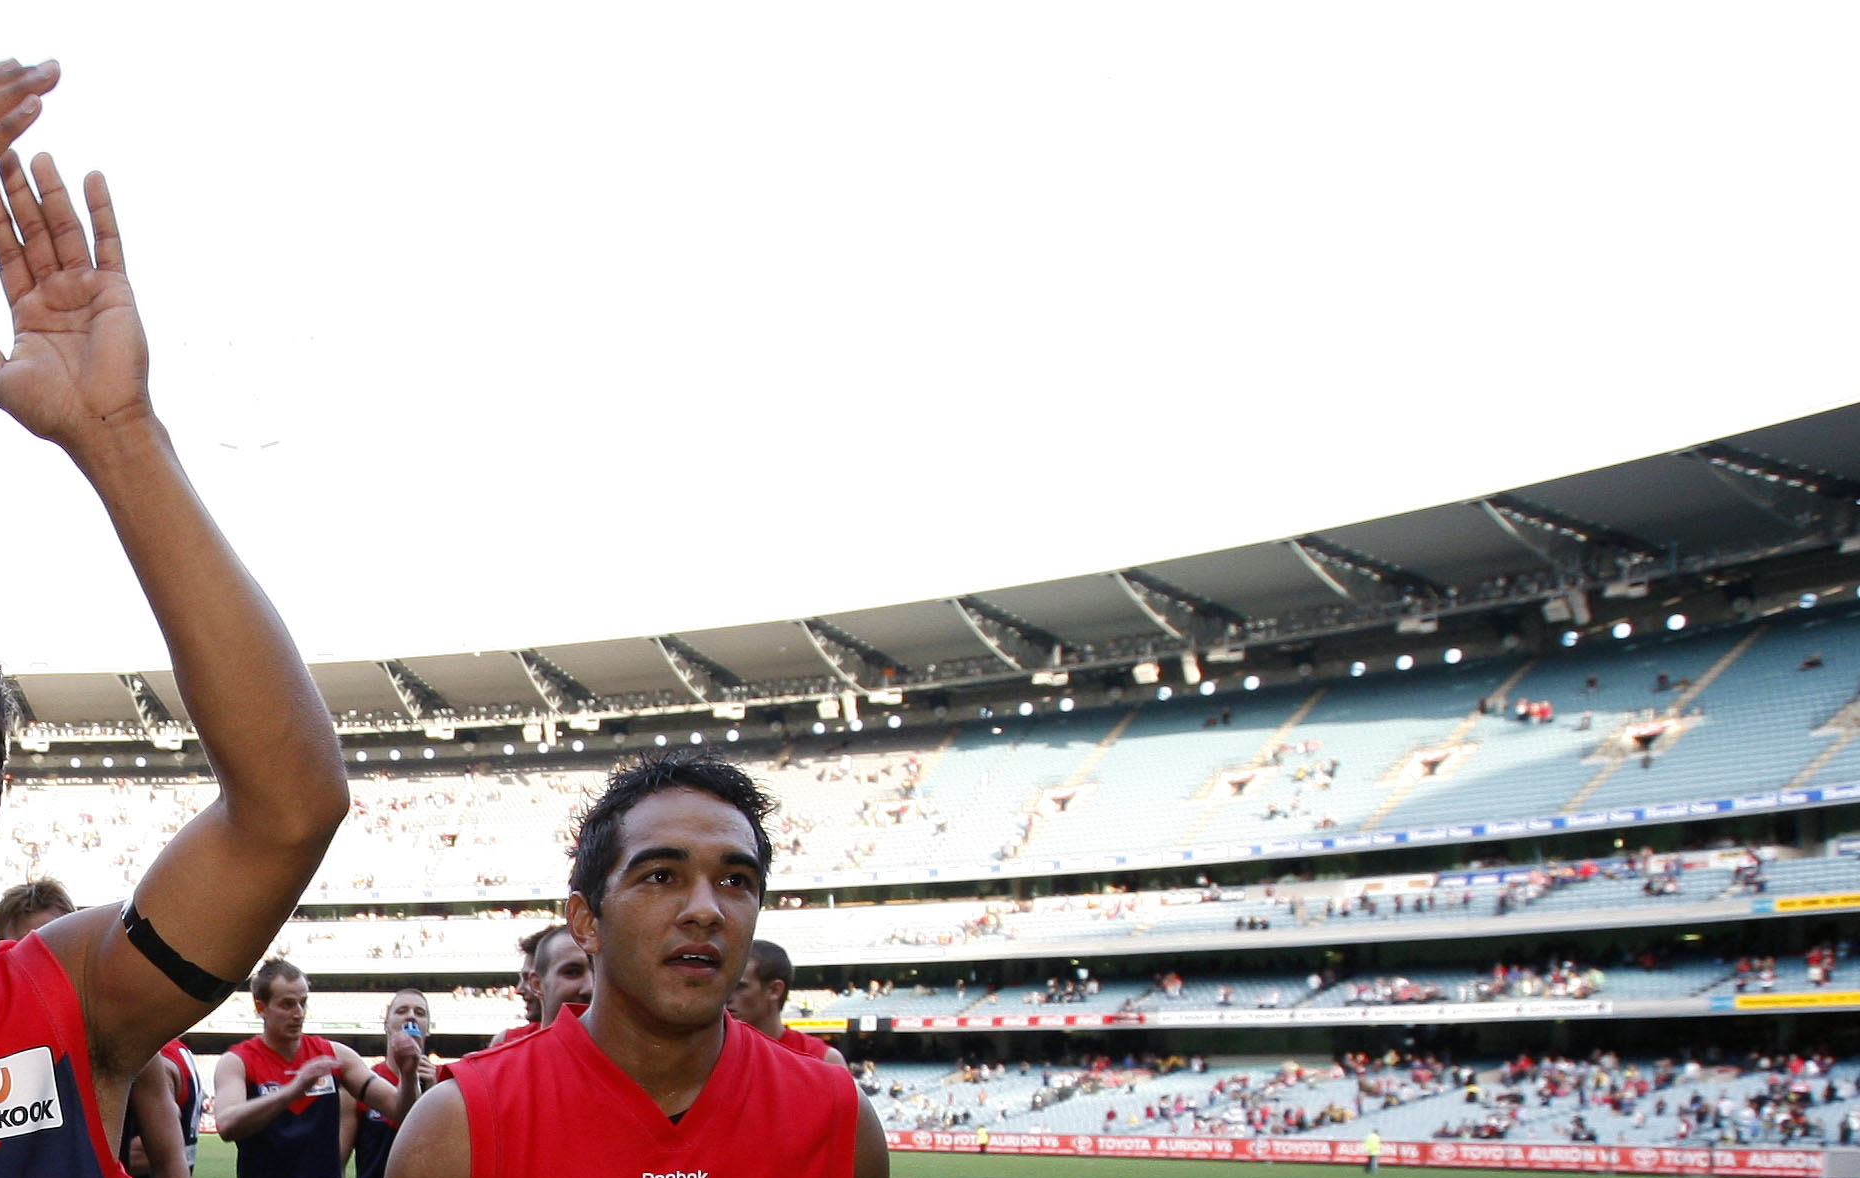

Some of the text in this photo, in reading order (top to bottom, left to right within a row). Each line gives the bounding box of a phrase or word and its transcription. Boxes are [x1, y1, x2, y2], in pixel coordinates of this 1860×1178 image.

[990, 1135, 1040, 1148] AURION
[1097, 1137, 1151, 1151] TOYOTA
[1156, 1138, 1213, 1152] AURION
[1272, 1141, 1331, 1155] TOYOTA
[1460, 1145, 1524, 1161] TOYOTA
[1528, 1147, 1596, 1163] AURION
[1661, 1150, 1822, 1169] TOYOTA AURION
